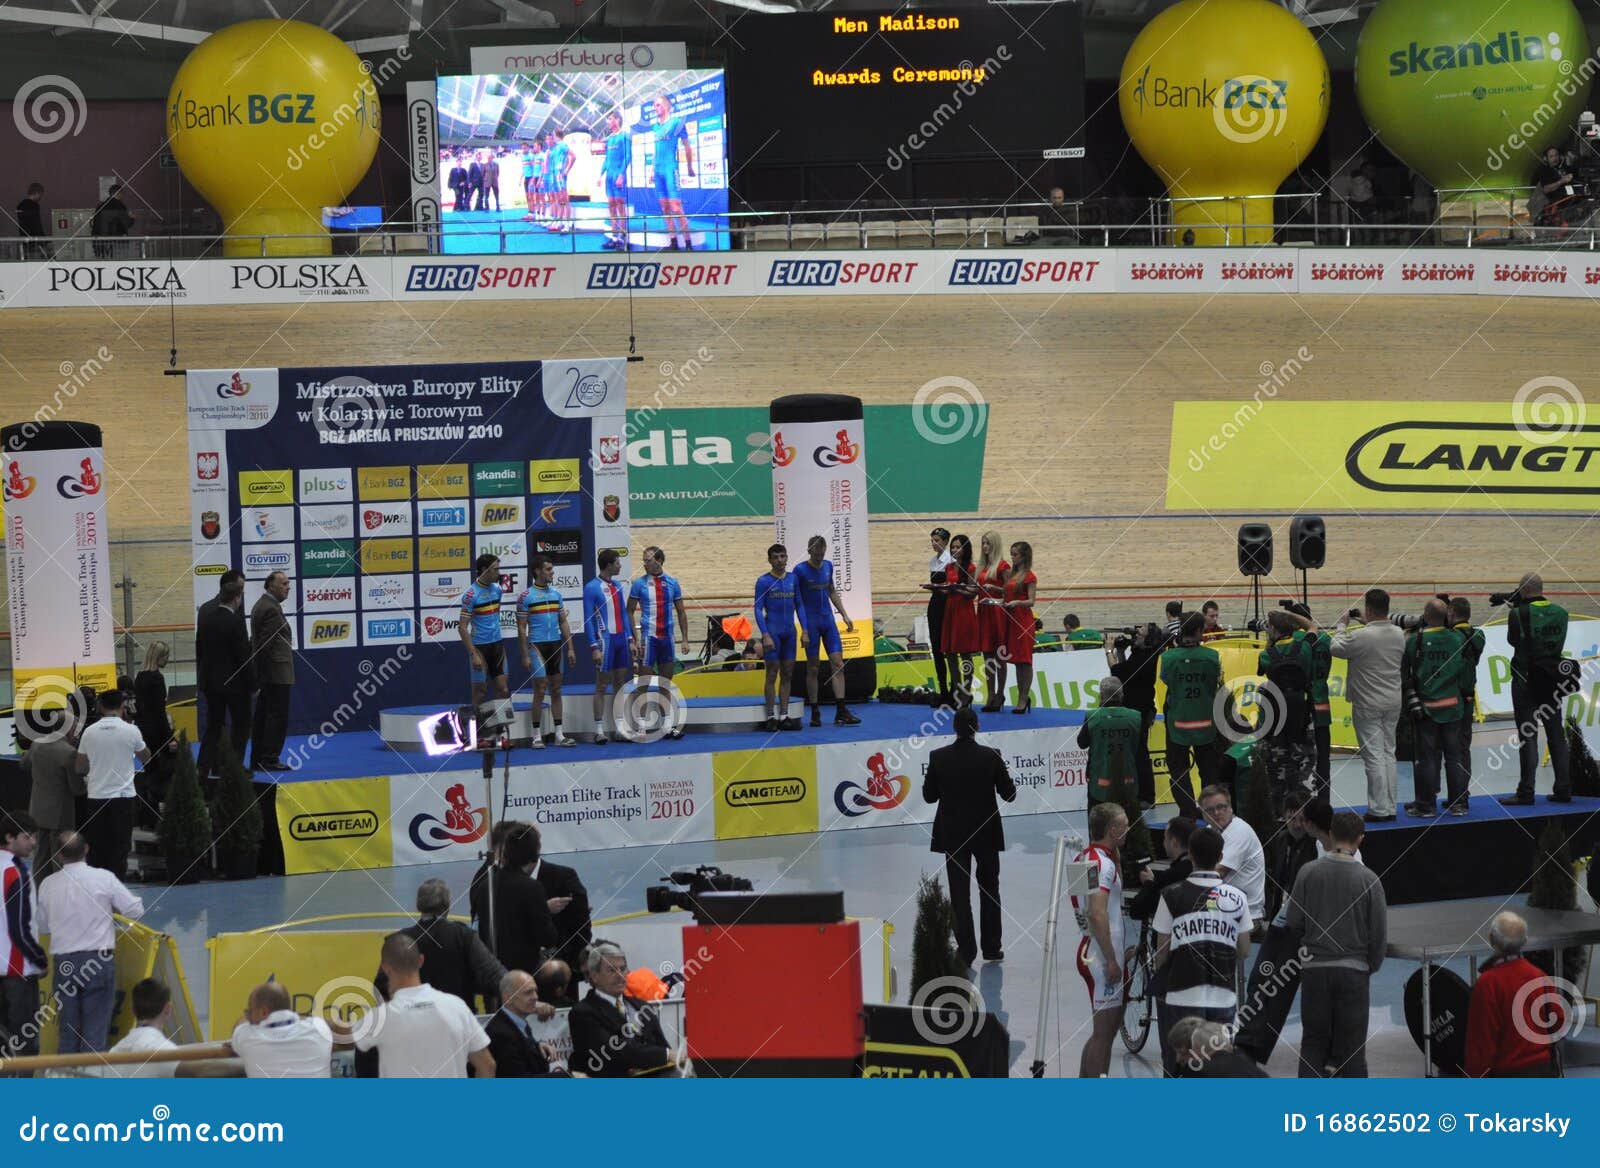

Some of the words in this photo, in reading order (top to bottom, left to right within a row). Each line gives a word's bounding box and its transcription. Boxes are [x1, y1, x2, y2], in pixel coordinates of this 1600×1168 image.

[834, 17, 868, 33] Men
[880, 15, 960, 31] Madison
[505, 48, 625, 69] mindfuture
[813, 70, 881, 85] Awards
[893, 67, 985, 84] Ceremony
[1154, 78, 1217, 108] Bank
[185, 96, 243, 129] Bank
[416, 107, 430, 178] LANGTEAM
[48, 266, 186, 292] POLSKA
[231, 264, 369, 289] POLSKA
[1131, 268, 1204, 280] SPORTOWY
[1221, 268, 1294, 280] SPORTOWY
[1311, 269, 1385, 281] SPORTOWY
[1402, 269, 1475, 281] SPORTOWY
[1494, 269, 1568, 283] SPORTOWY
[296, 382, 407, 400] Mistrzostwa
[412, 379, 477, 400] Europy
[481, 376, 523, 398] Elity
[249, 412, 269, 420] 2010
[297, 411, 312, 422] w
[318, 405, 404, 422] Kolarstwie
[408, 403, 483, 423] Torowym
[348, 428, 391, 444] ARENA
[395, 423, 464, 443] PRUSZKÓW
[468, 424, 503, 439] 2010
[476, 469, 517, 480] skandia
[304, 477, 336, 495] plus
[630, 492, 655, 500] OLD
[659, 491, 712, 500] MUTUAL
[841, 480, 851, 512] 2010
[428, 512, 451, 522] TVP
[484, 507, 517, 523] RMF
[14, 516, 25, 549] 2010
[87, 512, 97, 545] 2010
[831, 518, 840, 542] Track
[249, 554, 287, 563] novum
[304, 549, 346, 559] skandia
[832, 545, 841, 567] Elite
[842, 517, 852, 592] Championships
[78, 553, 87, 581] Track
[79, 583, 88, 606] Elite
[89, 552, 100, 633] Championships
[81, 609, 92, 657] European
[314, 624, 348, 639] RMF
[373, 625, 397, 634] TVP
[400, 621, 407, 633] 1
[1013, 754, 1046, 767] Track
[1053, 751, 1088, 760] WARSZAW
[650, 779, 694, 790] WARSZAWA
[731, 784, 801, 801] LANGTEAM
[505, 794, 568, 810] European
[572, 788, 602, 804] Elite
[605, 785, 641, 800] Track
[536, 804, 642, 825] Championships
[651, 799, 695, 820] 2010
[297, 818, 373, 833] LANGTEAM
